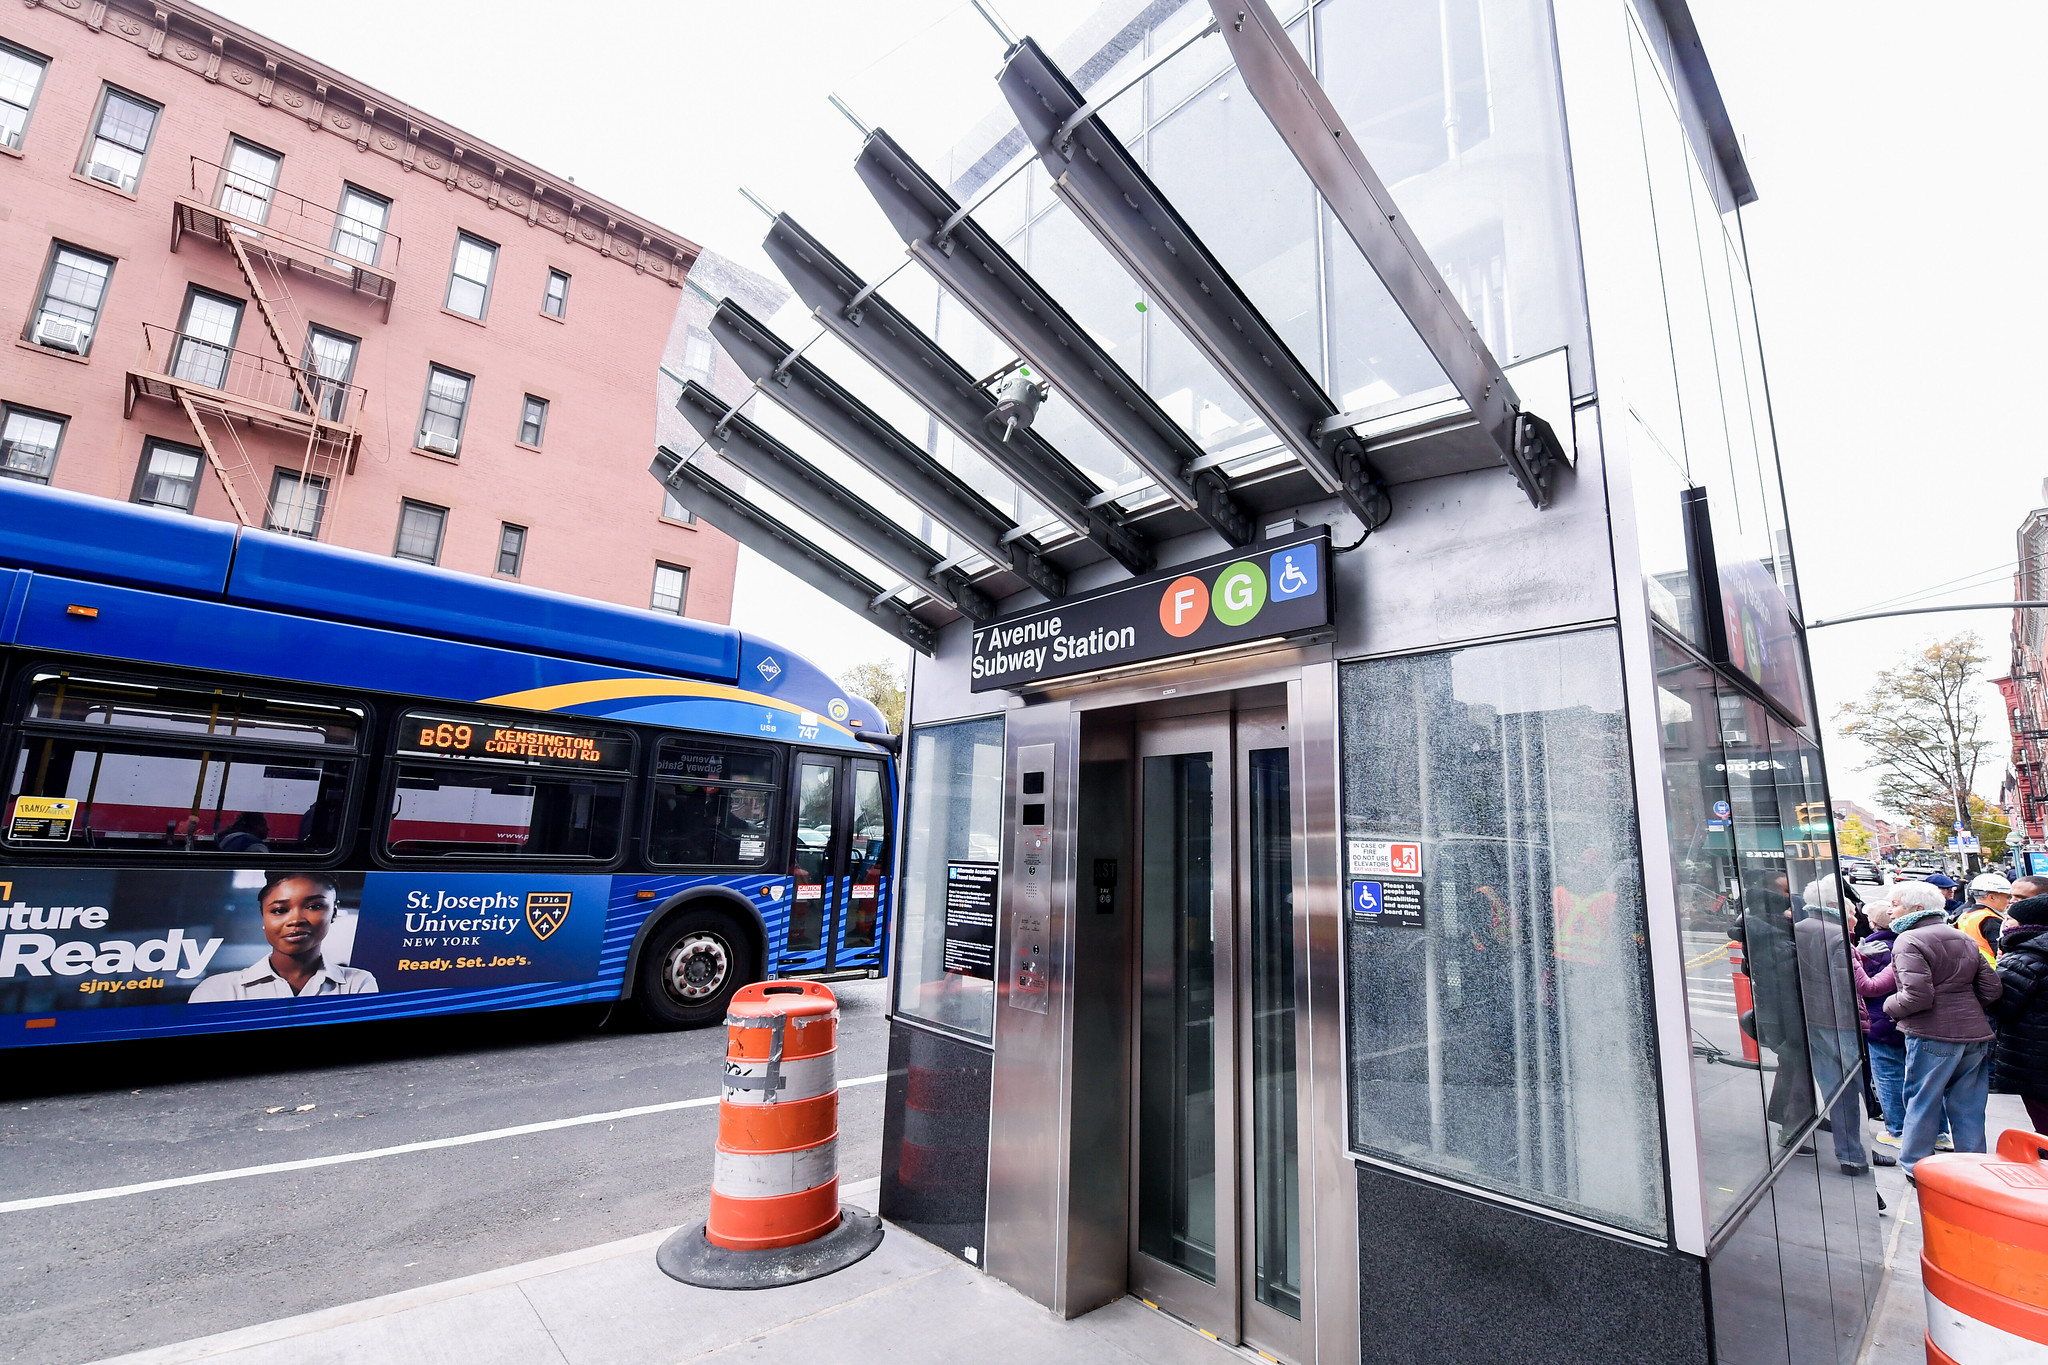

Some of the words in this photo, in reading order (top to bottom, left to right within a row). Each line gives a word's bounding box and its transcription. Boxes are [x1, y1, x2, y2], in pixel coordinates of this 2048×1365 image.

[1224, 573, 1253, 612] G
[1174, 588, 1195, 625] F
[973, 632, 984, 655] 7
[988, 616, 1062, 652] Avenue
[972, 645, 1047, 679] Subway
[1053, 626, 1136, 662] Station
[760, 664, 777, 674] CNG
[419, 723, 473, 750] B69
[760, 724, 777, 733] USB
[797, 726, 820, 740] 747
[494, 729, 595, 750] KENSINGTON
[484, 740, 577, 760] CORTELYOU
[580, 749, 601, 762] RD
[20, 804, 51, 814] TRANSIT
[406, 890, 432, 910] St.
[432, 890, 519, 915] Joseph's
[537, 896, 560, 904] 1916
[1383, 895, 1418, 903] disabilities
[404, 912, 521, 935] University
[402, 937, 437, 947] NEW
[442, 936, 480, 946] YORK
[0, 928, 224, 979] Ready
[397, 957, 453, 971] Ready.
[455, 956, 486, 969] Set.
[79, 976, 164, 994] sjny.edu
